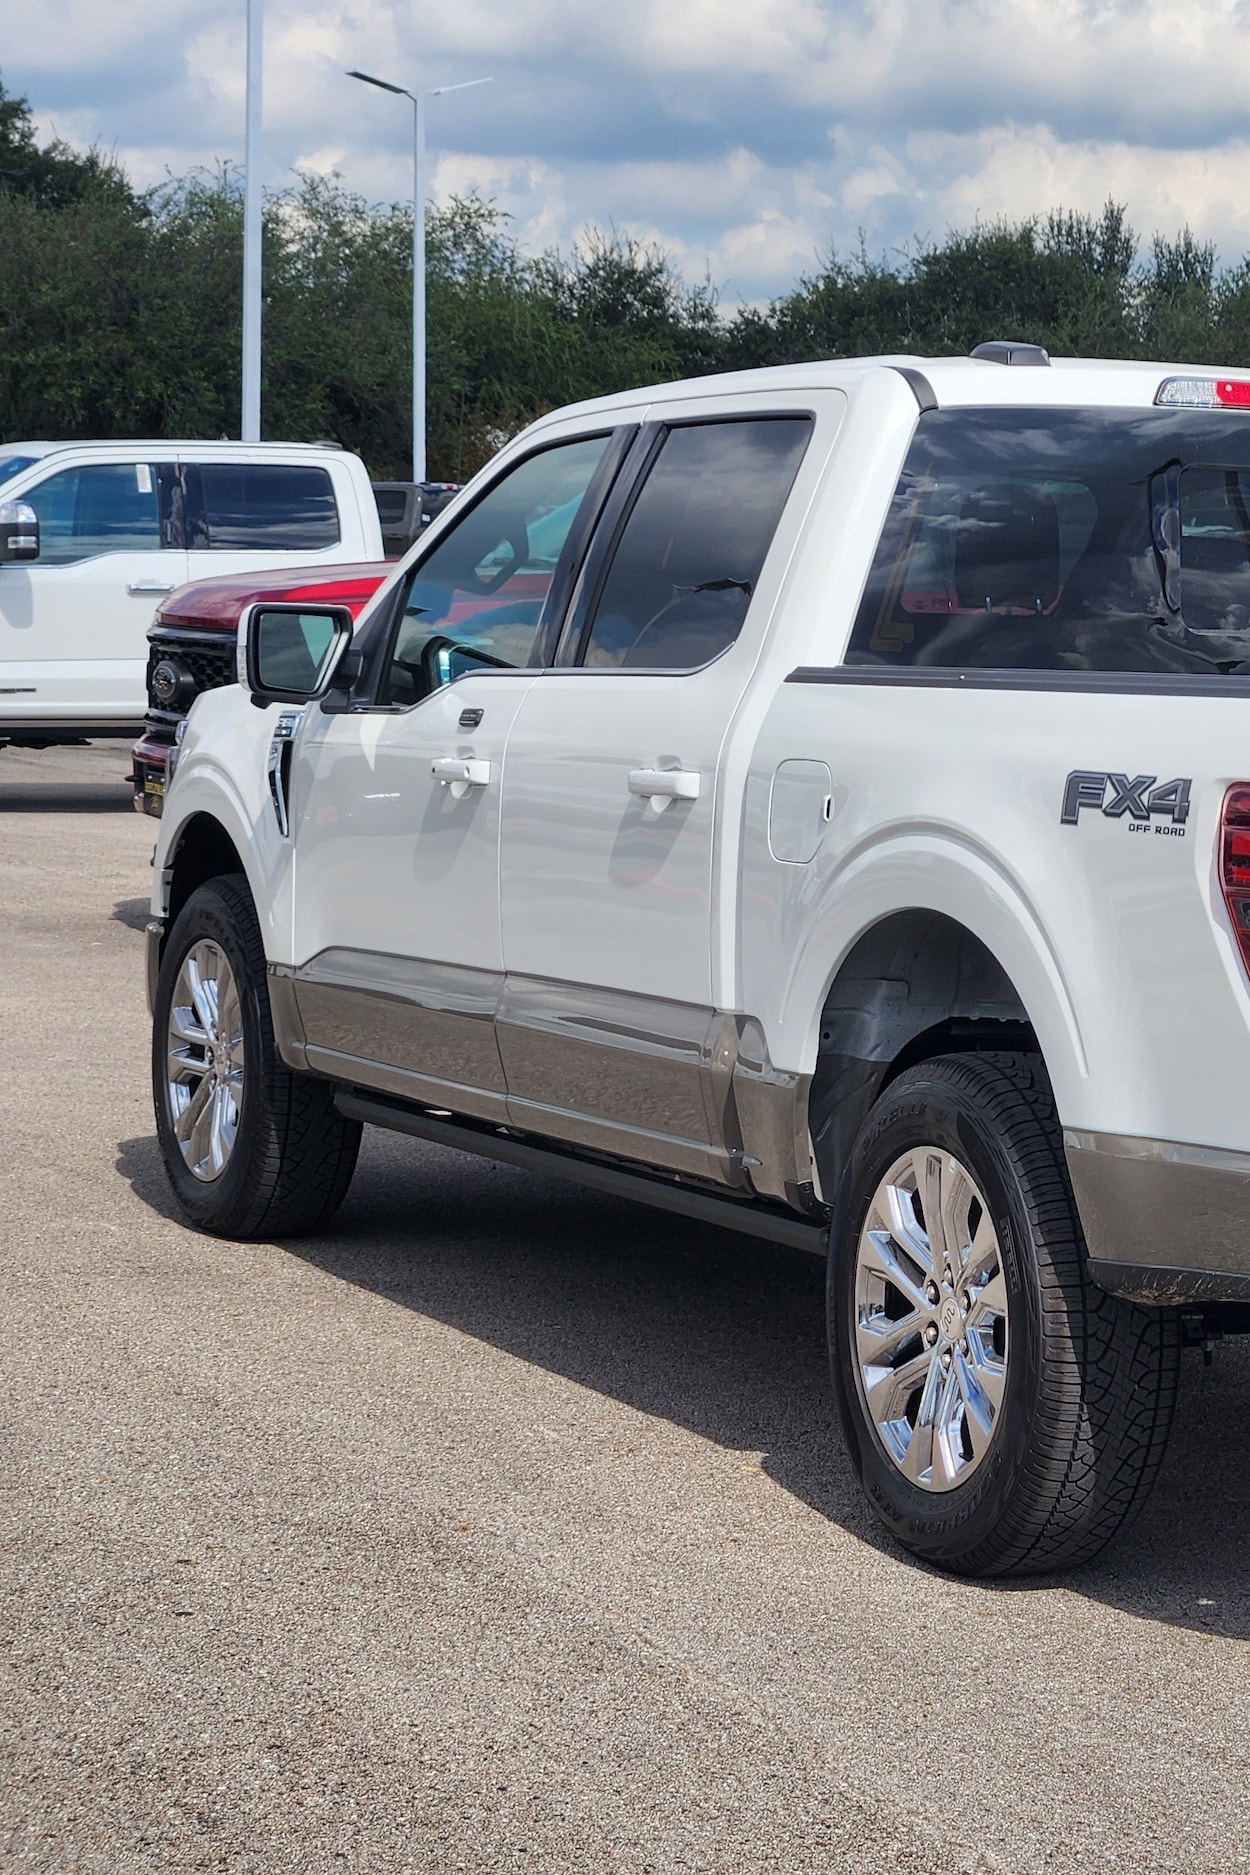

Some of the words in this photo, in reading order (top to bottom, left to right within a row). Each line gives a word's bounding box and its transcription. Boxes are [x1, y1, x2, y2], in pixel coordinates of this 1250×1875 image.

[1060, 769, 1193, 826] FX4
[1128, 823, 1151, 834] OFF
[1154, 826, 1186, 837] ROAD
